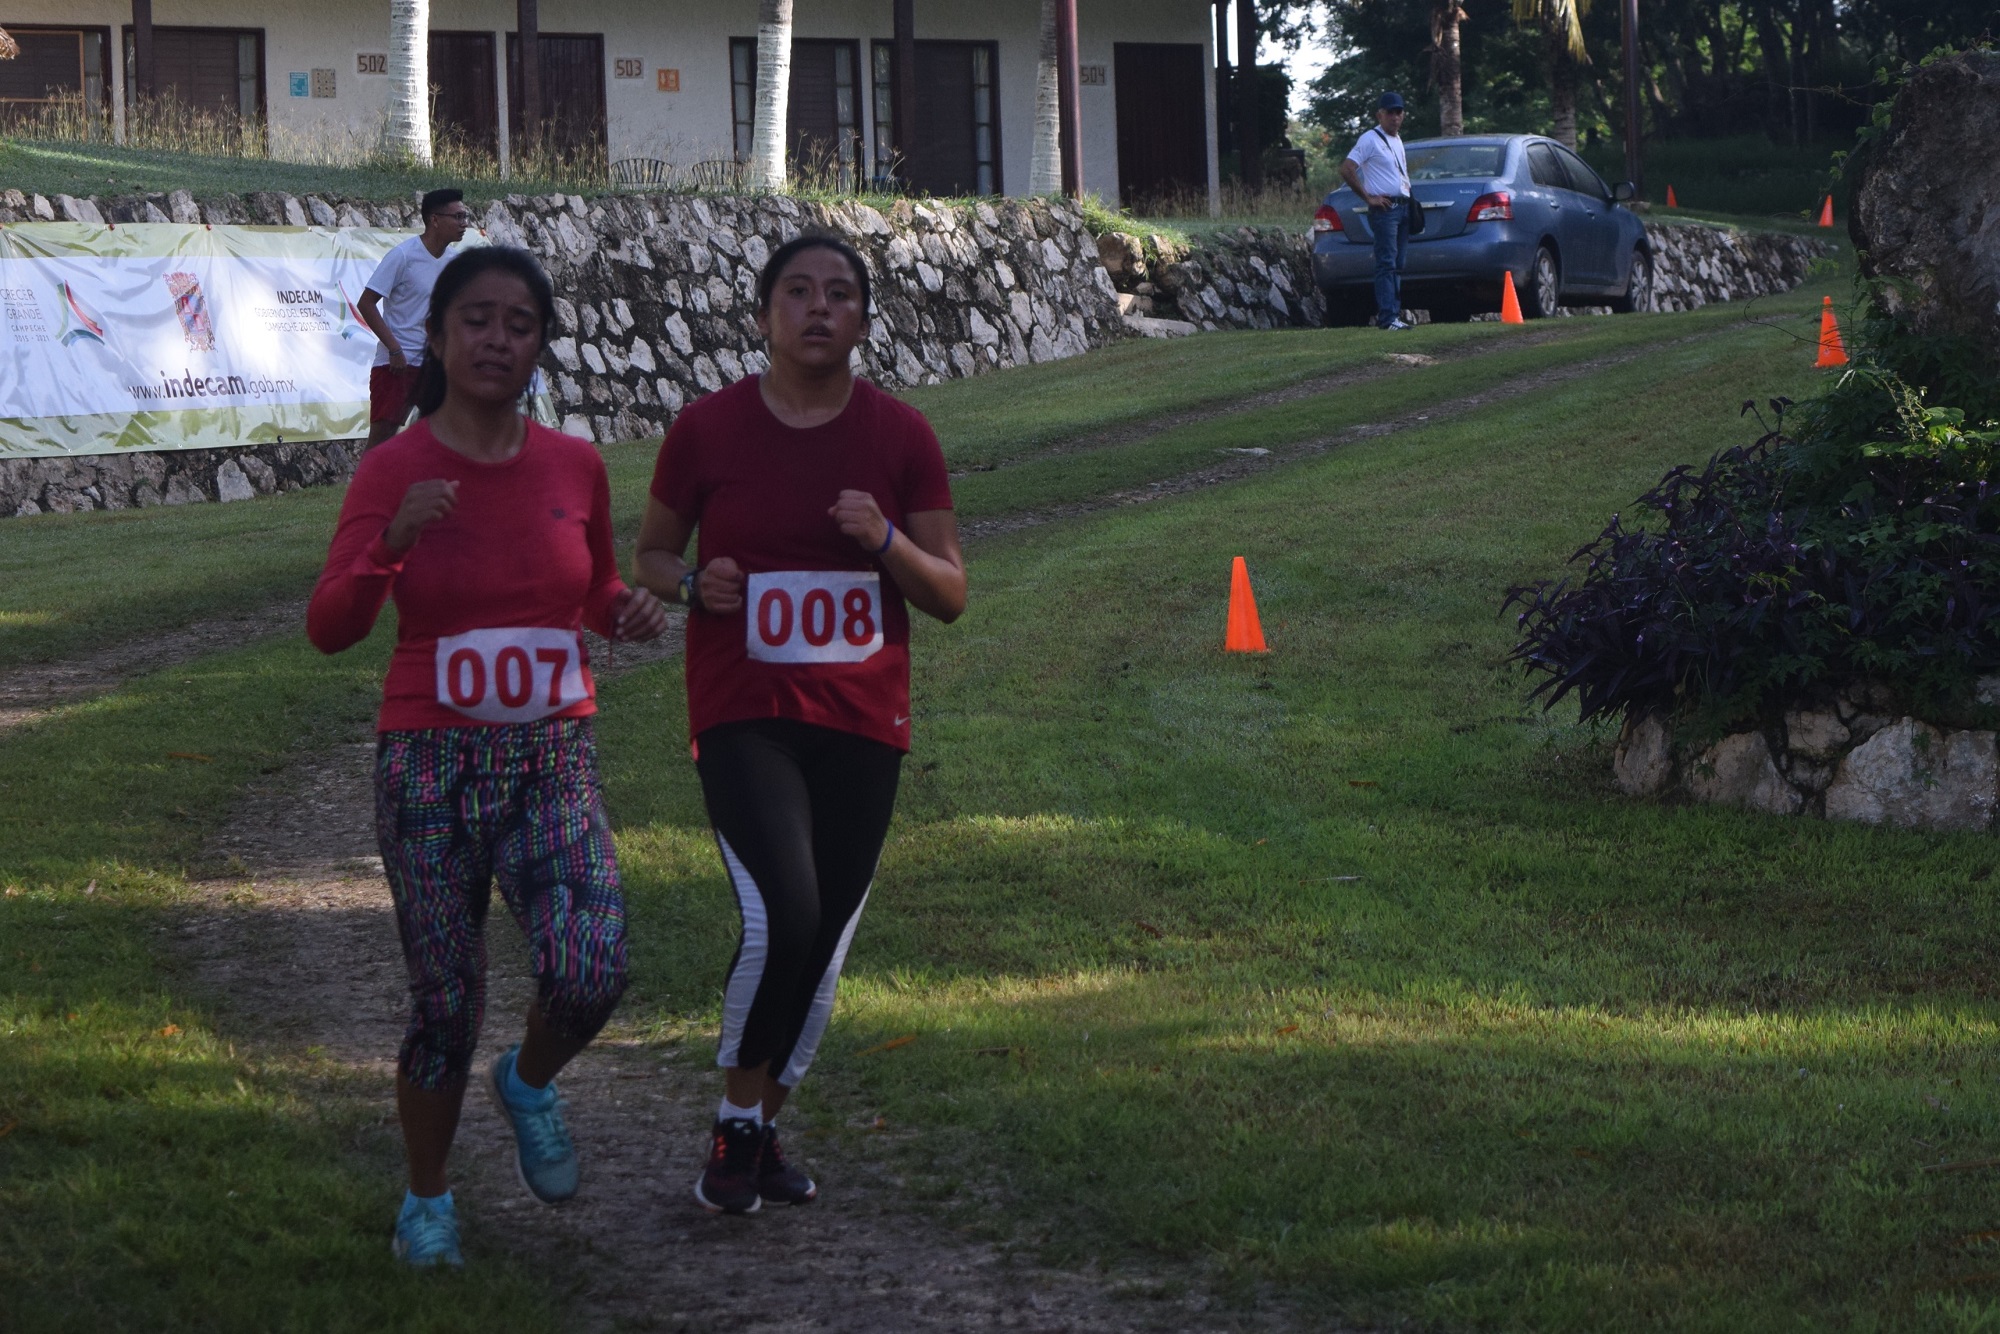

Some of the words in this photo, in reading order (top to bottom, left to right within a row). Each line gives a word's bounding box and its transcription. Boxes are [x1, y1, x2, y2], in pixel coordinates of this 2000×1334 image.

[358, 55, 386, 73] 502
[616, 59, 642, 77] 503
[1081, 66, 1105, 84] 504
[0, 289, 36, 301] CRECER
[277, 290, 324, 304] INDECAM
[7, 308, 42, 320] GRANDE
[286, 308, 300, 318] DEL
[300, 307, 326, 318] ESTADO
[11, 324, 47, 332] CAMPECHE
[299, 321, 332, 332] 2015-2021
[15, 334, 30, 342] 2015
[36, 334, 50, 342] 2021
[127, 368, 298, 400] www.indecam.gob.mx
[757, 587, 876, 647] 008
[446, 645, 569, 709] 007
